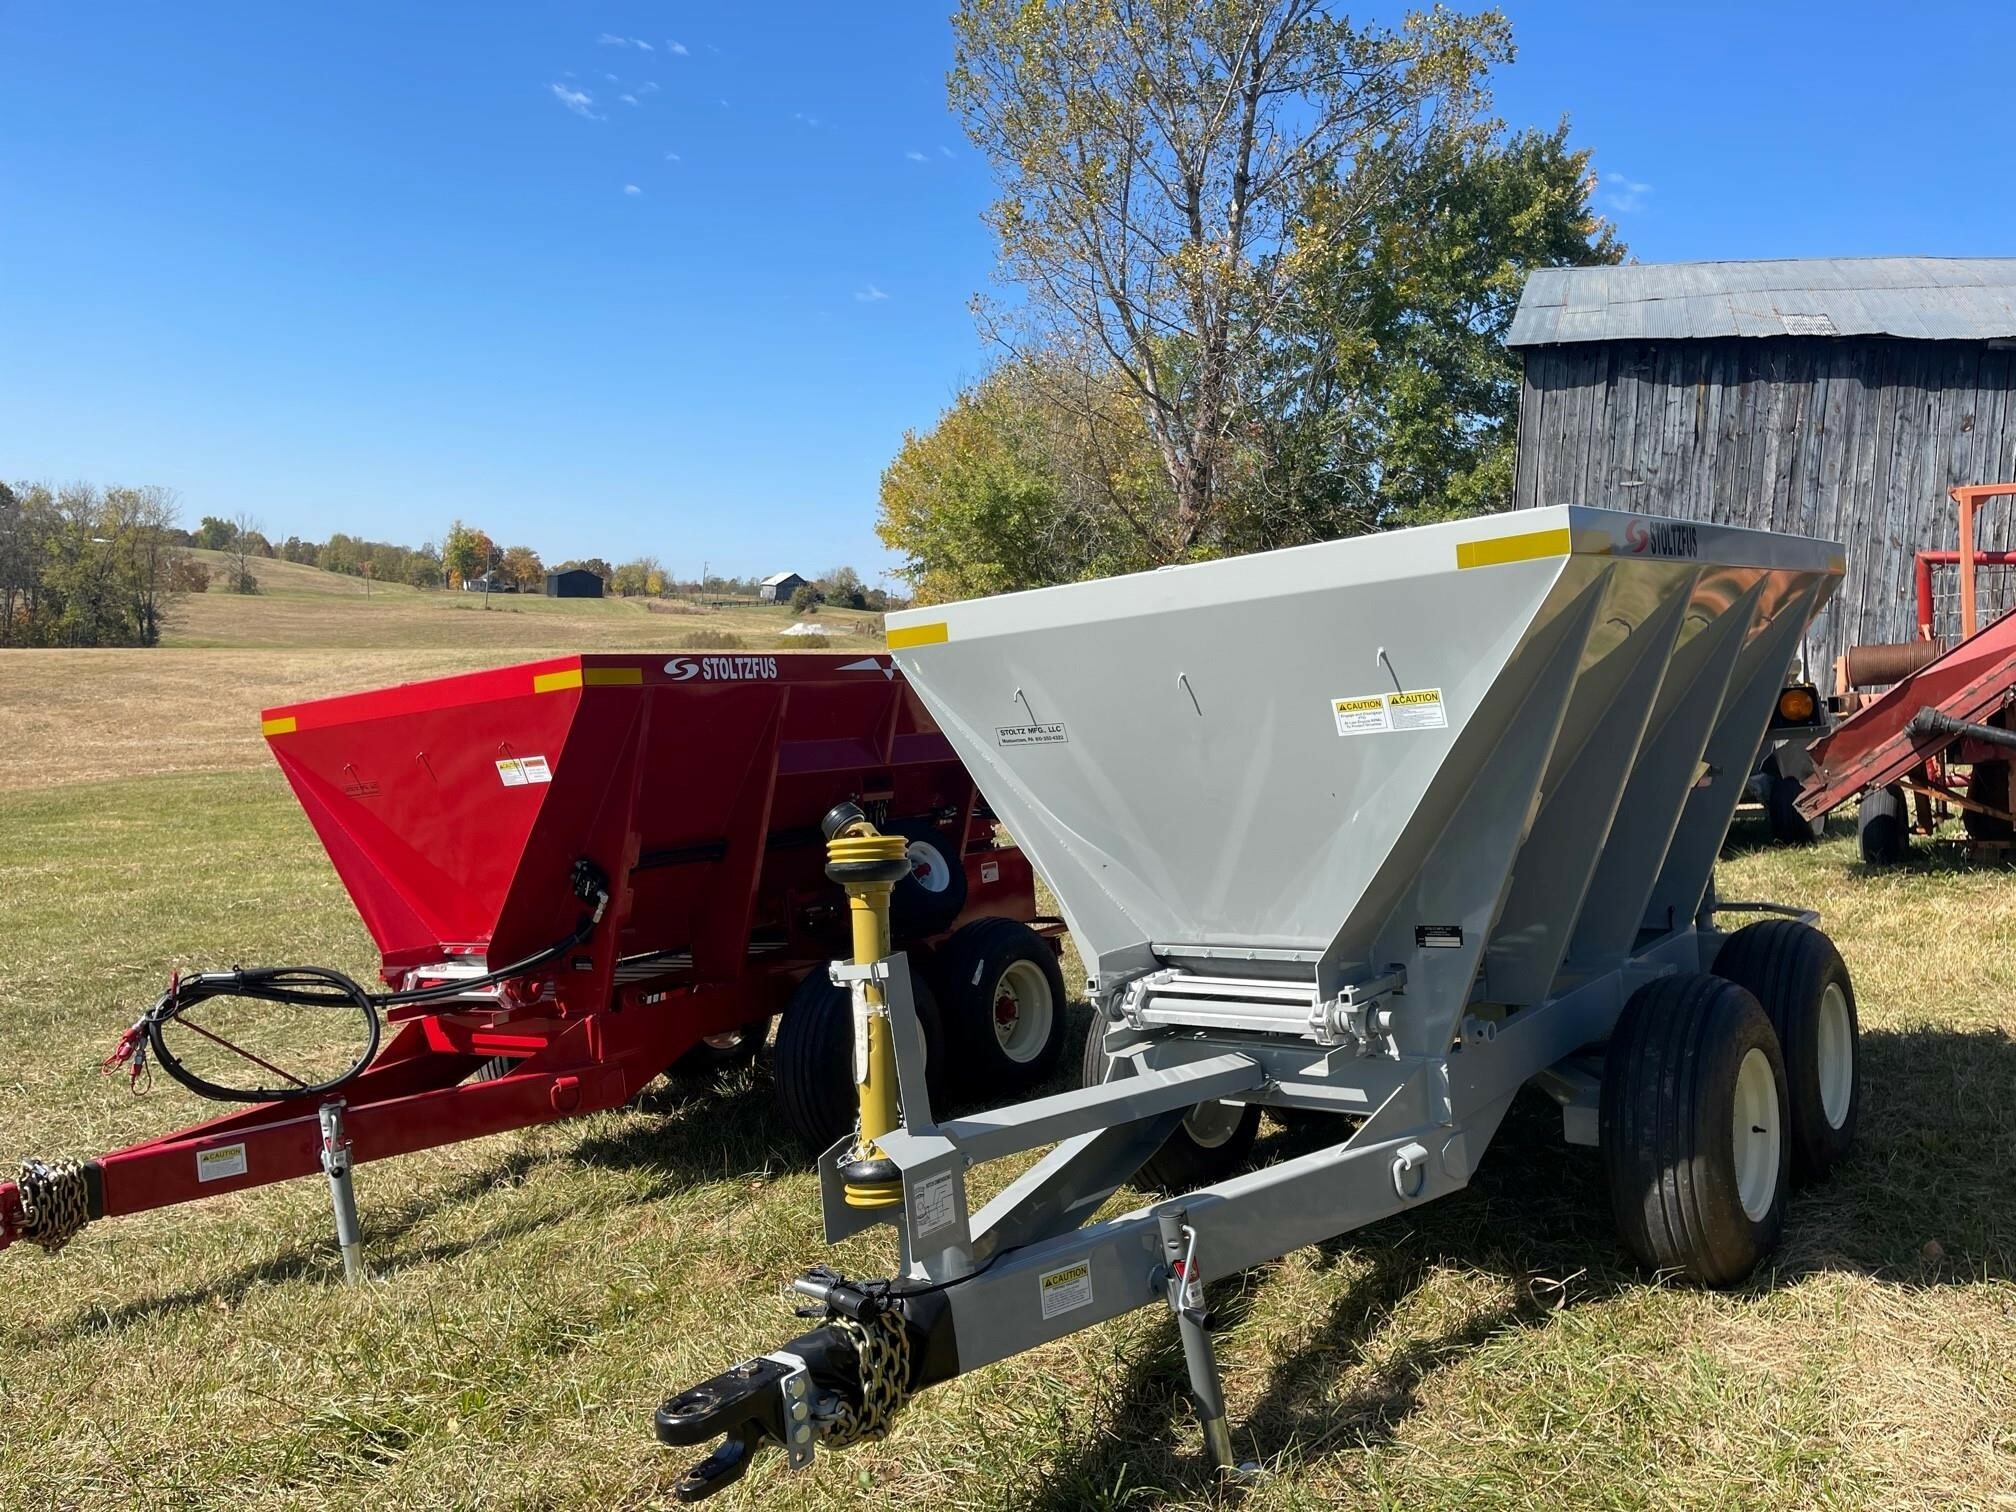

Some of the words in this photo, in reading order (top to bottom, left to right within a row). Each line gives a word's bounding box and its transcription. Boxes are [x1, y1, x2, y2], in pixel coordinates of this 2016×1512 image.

[1649, 521, 1698, 558] STOLTZFUS
[702, 657, 778, 680] STOLTZFUS
[1399, 693, 1438, 704] CAUTION
[1346, 700, 1382, 711] CAUTION
[1000, 728, 1026, 736] STOLTZ
[1048, 725, 1062, 733] LLC
[209, 1149, 241, 1160] CAUTION
[1052, 1266, 1087, 1285] CAUTION
